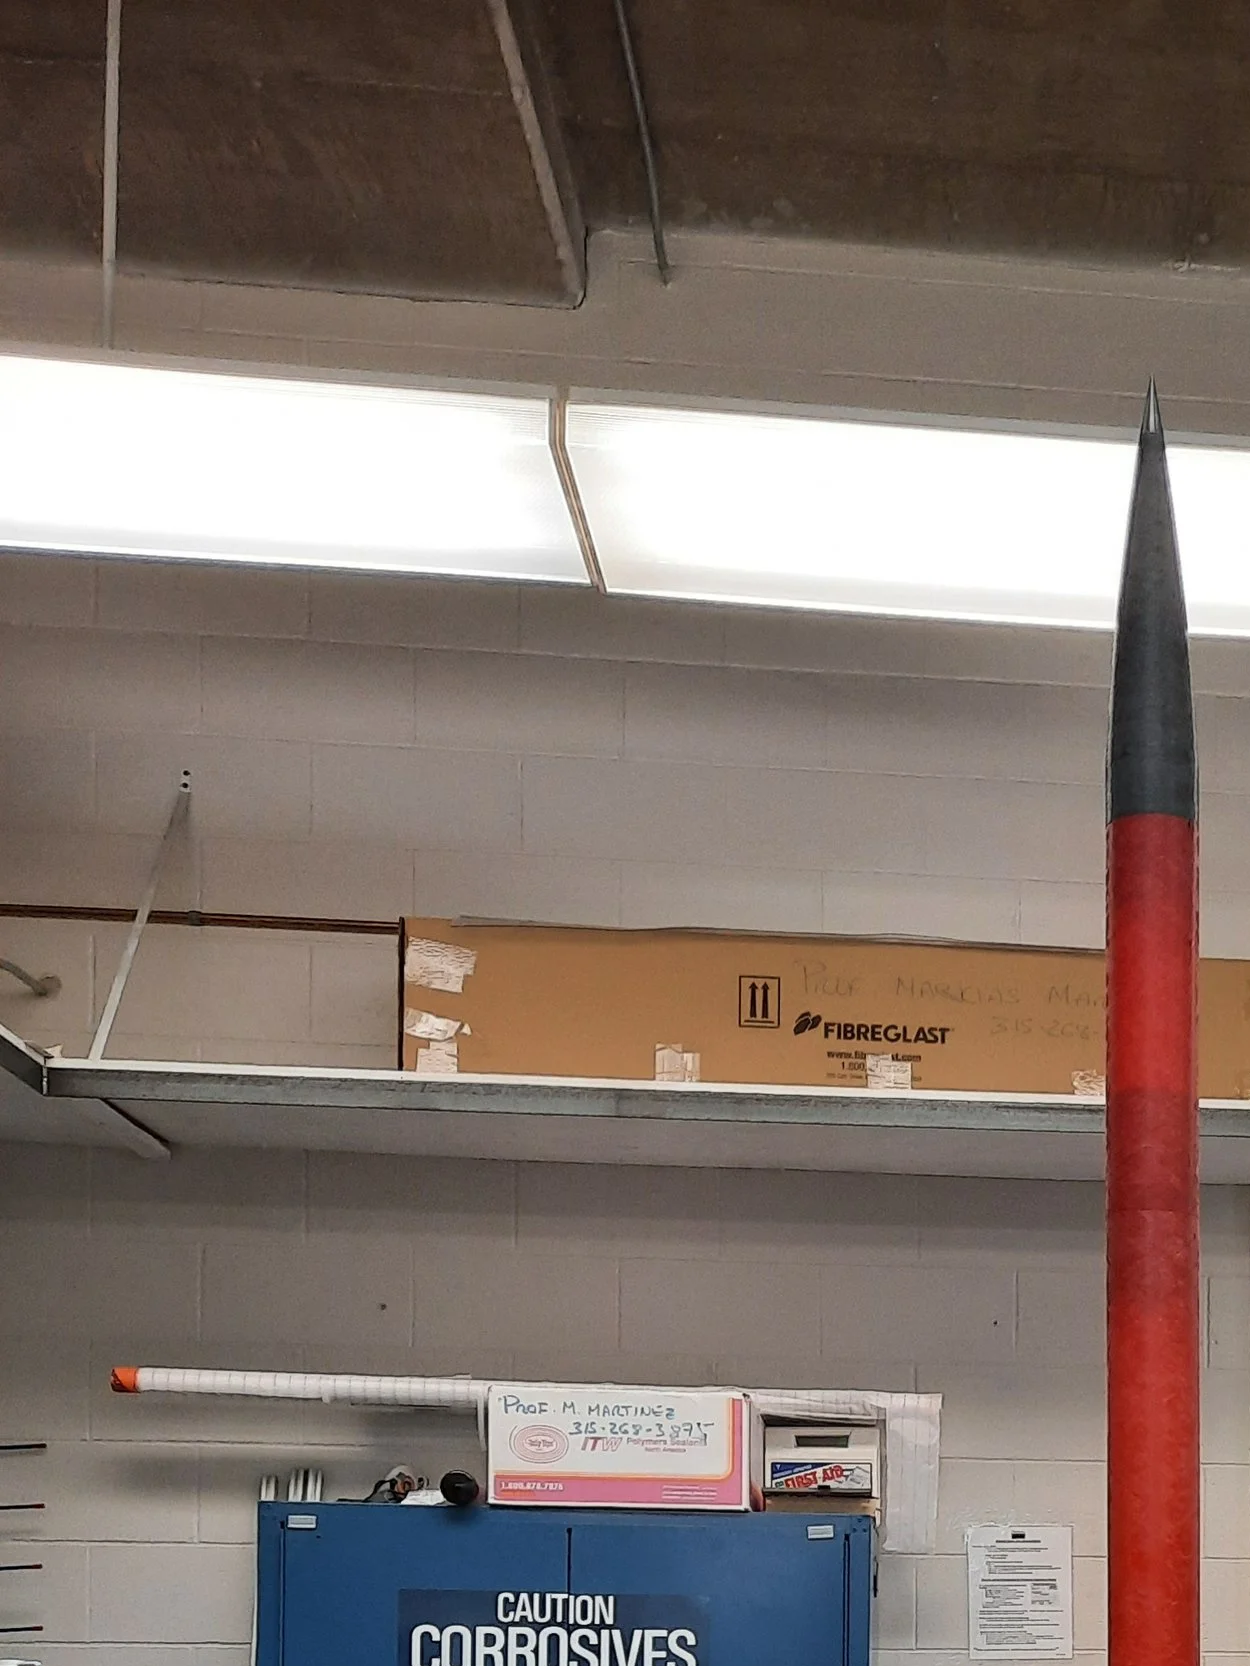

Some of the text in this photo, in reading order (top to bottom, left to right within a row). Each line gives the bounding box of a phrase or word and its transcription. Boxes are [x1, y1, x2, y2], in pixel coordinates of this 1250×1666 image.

[824, 1022, 950, 1044] FIBREGLAST
[587, 1403, 675, 1419] MARTINEZ
[581, 1436, 622, 1451] ITW
[497, 1592, 614, 1625] CAUTION
